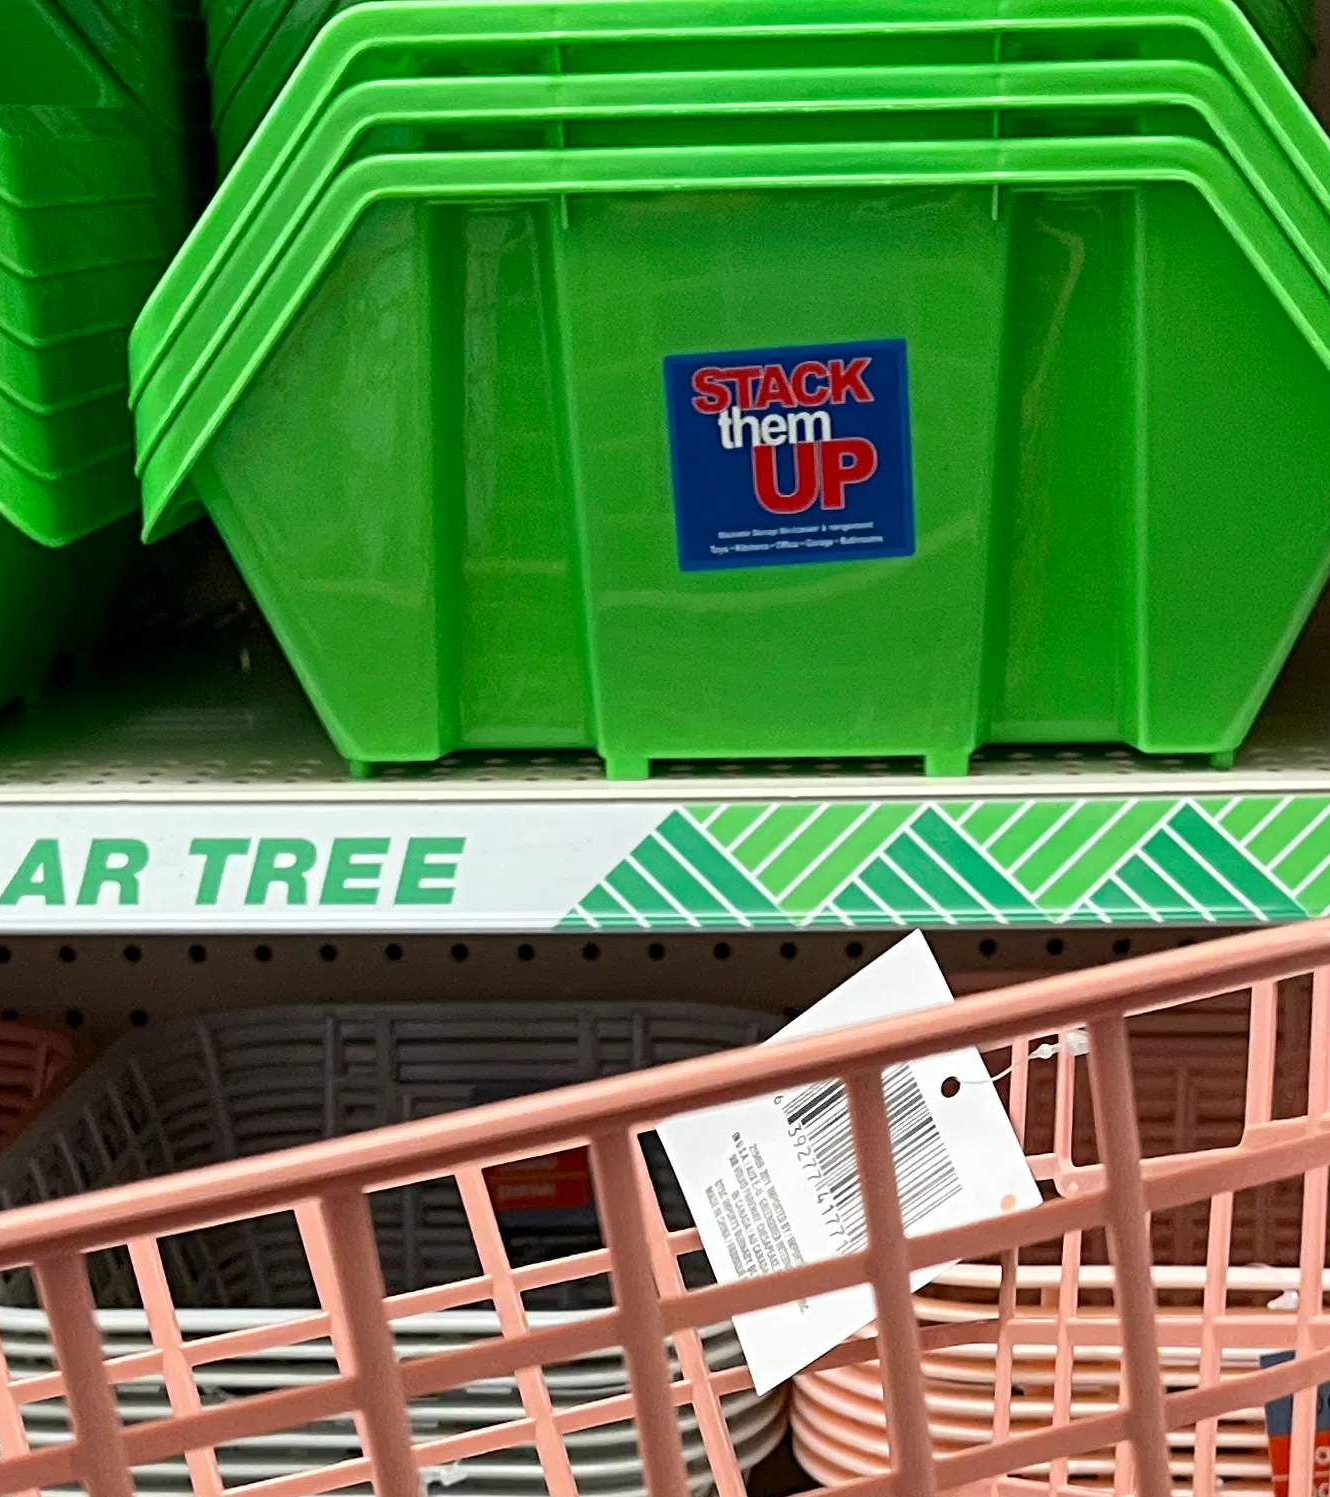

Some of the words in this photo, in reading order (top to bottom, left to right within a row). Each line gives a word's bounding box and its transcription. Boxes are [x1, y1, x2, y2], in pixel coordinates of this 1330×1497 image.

[690, 356, 875, 415] STACK
[717, 405, 832, 450] them
[751, 436, 878, 515] UP
[187, 836, 467, 907] TREE
